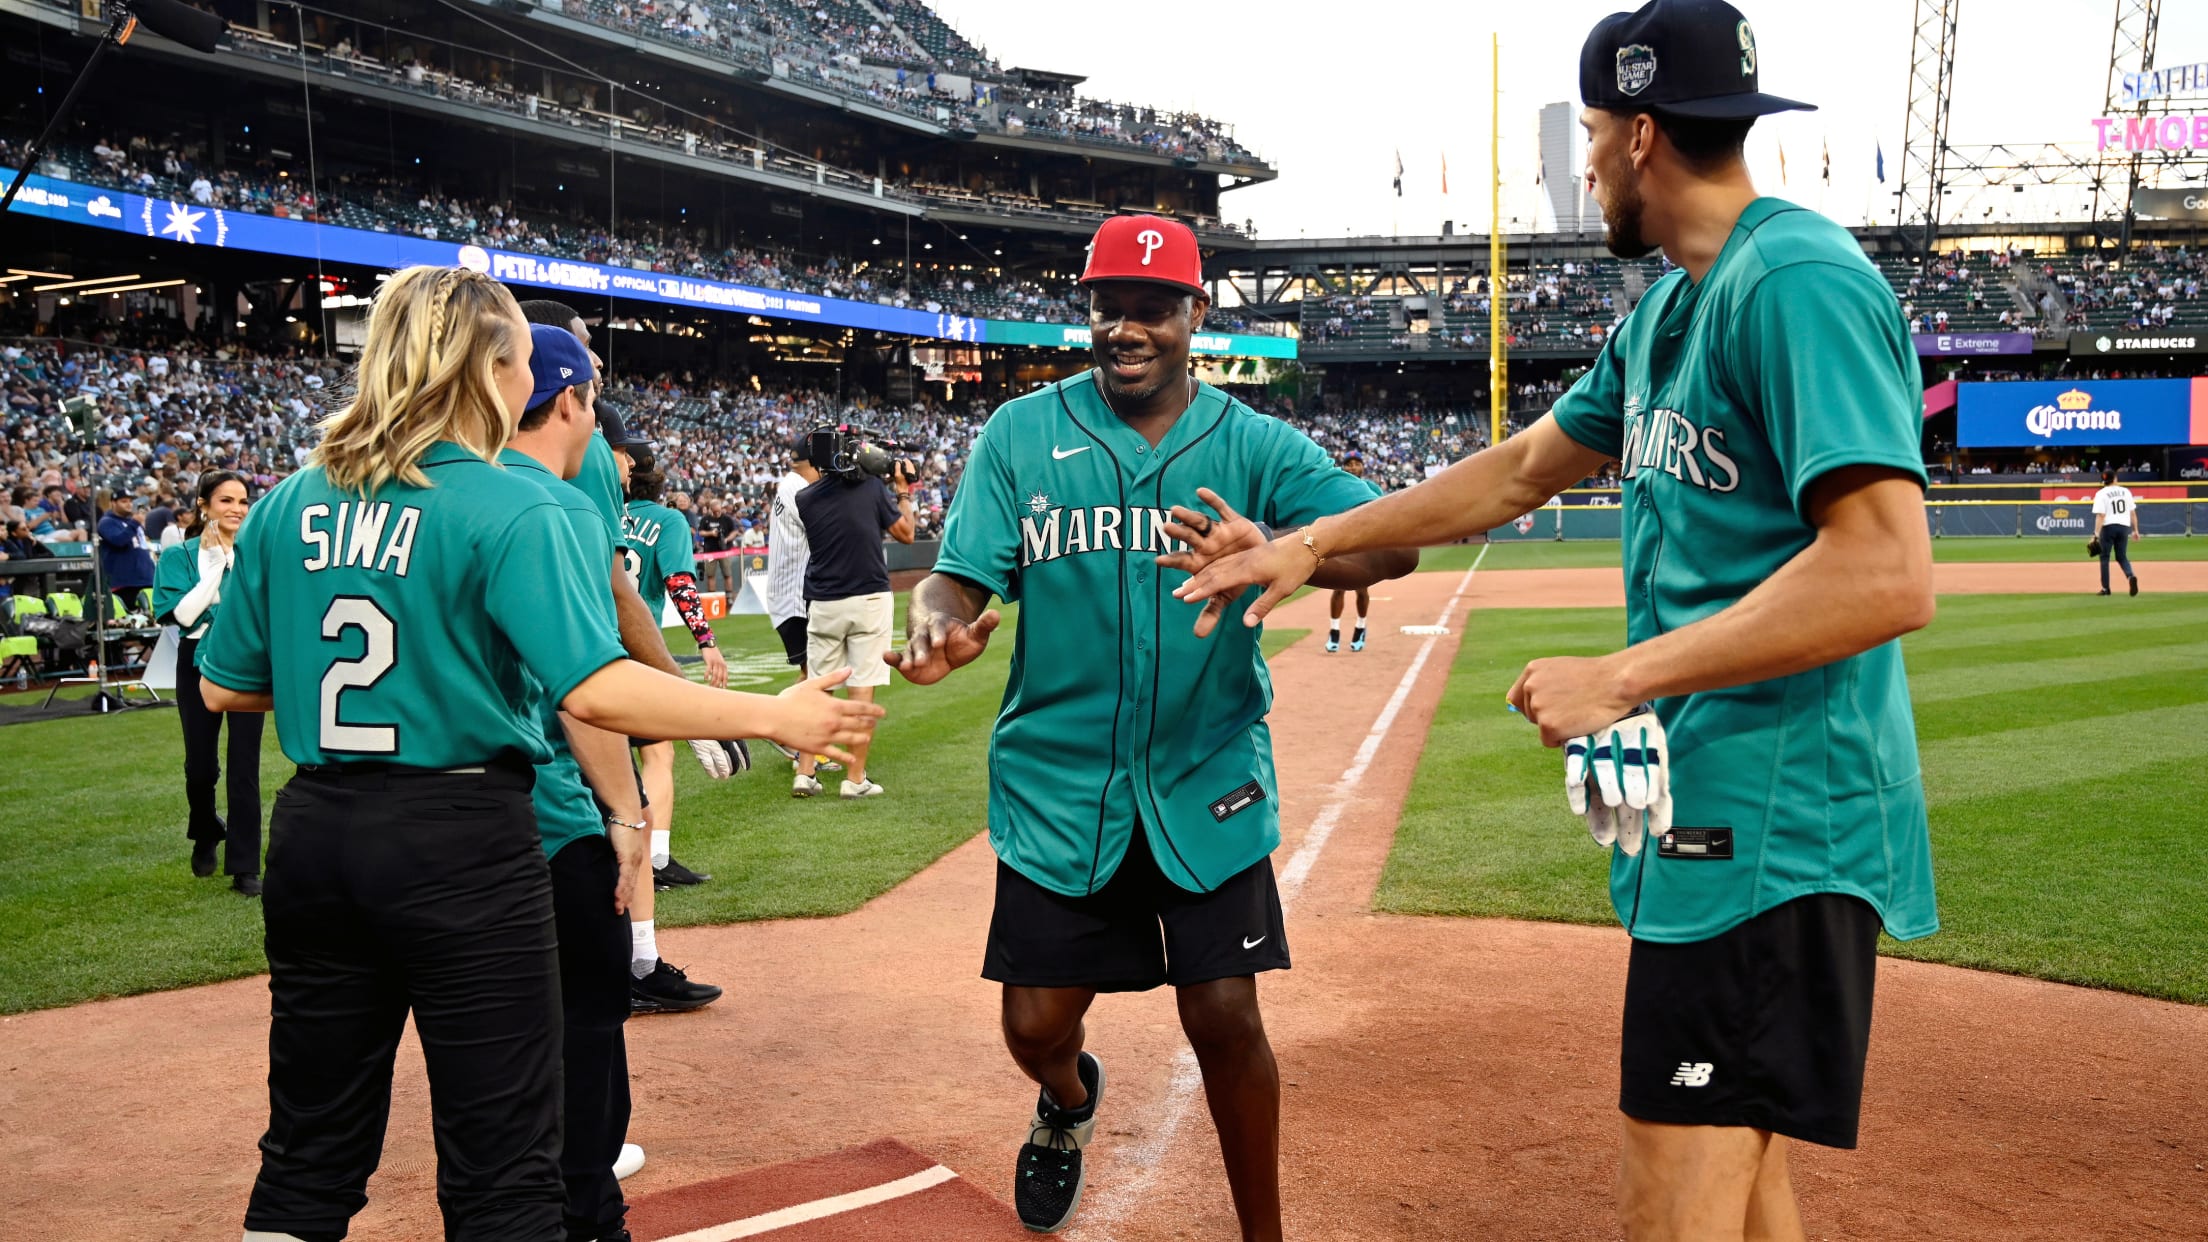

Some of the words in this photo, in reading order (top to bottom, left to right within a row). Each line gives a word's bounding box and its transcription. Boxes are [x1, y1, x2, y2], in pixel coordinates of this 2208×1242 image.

[2122, 64, 2208, 104] SEATTL
[2183, 195, 2208, 210] Go
[1137, 230, 1164, 265] P
[493, 254, 537, 281] PETE
[613, 274, 657, 292] OFFICIAL
[766, 296, 784, 310] 2023
[1955, 338, 2000, 348] Extreme
[2115, 337, 2196, 350] STARBUCKS
[2026, 404, 2121, 438] Corona
[2111, 498, 2126, 514] 10
[301, 500, 422, 577] SIWA
[620, 516, 661, 546] ELLO
[1020, 506, 1188, 567] MARIN
[2036, 515, 2085, 531] Corona
[711, 600, 720, 616] G
[319, 594, 399, 755] 2
